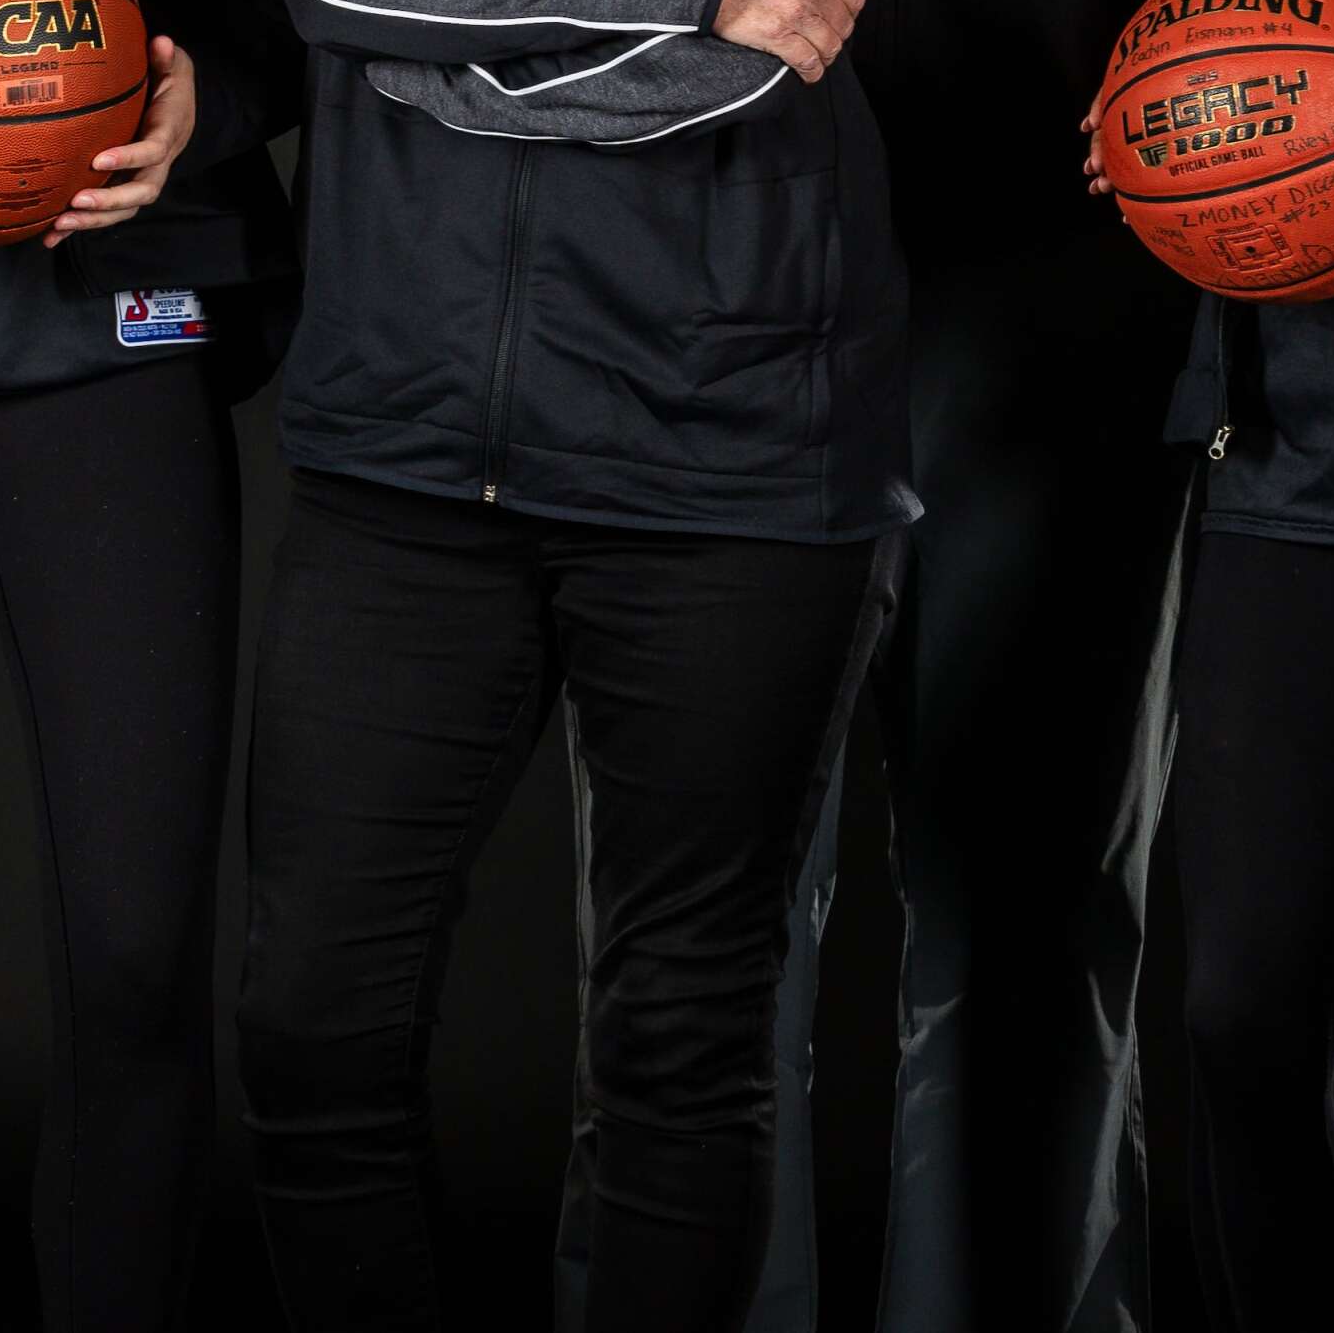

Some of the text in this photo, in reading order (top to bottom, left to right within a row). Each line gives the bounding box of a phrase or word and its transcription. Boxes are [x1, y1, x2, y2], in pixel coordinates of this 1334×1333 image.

[1262, 22, 1293, 36] #4
[0, 61, 60, 75] LEGEND
[1122, 69, 1311, 145] LEGACY
[1136, 114, 1296, 167] TF 1000
[1169, 146, 1266, 177] OFFICIAL GAME BALL
